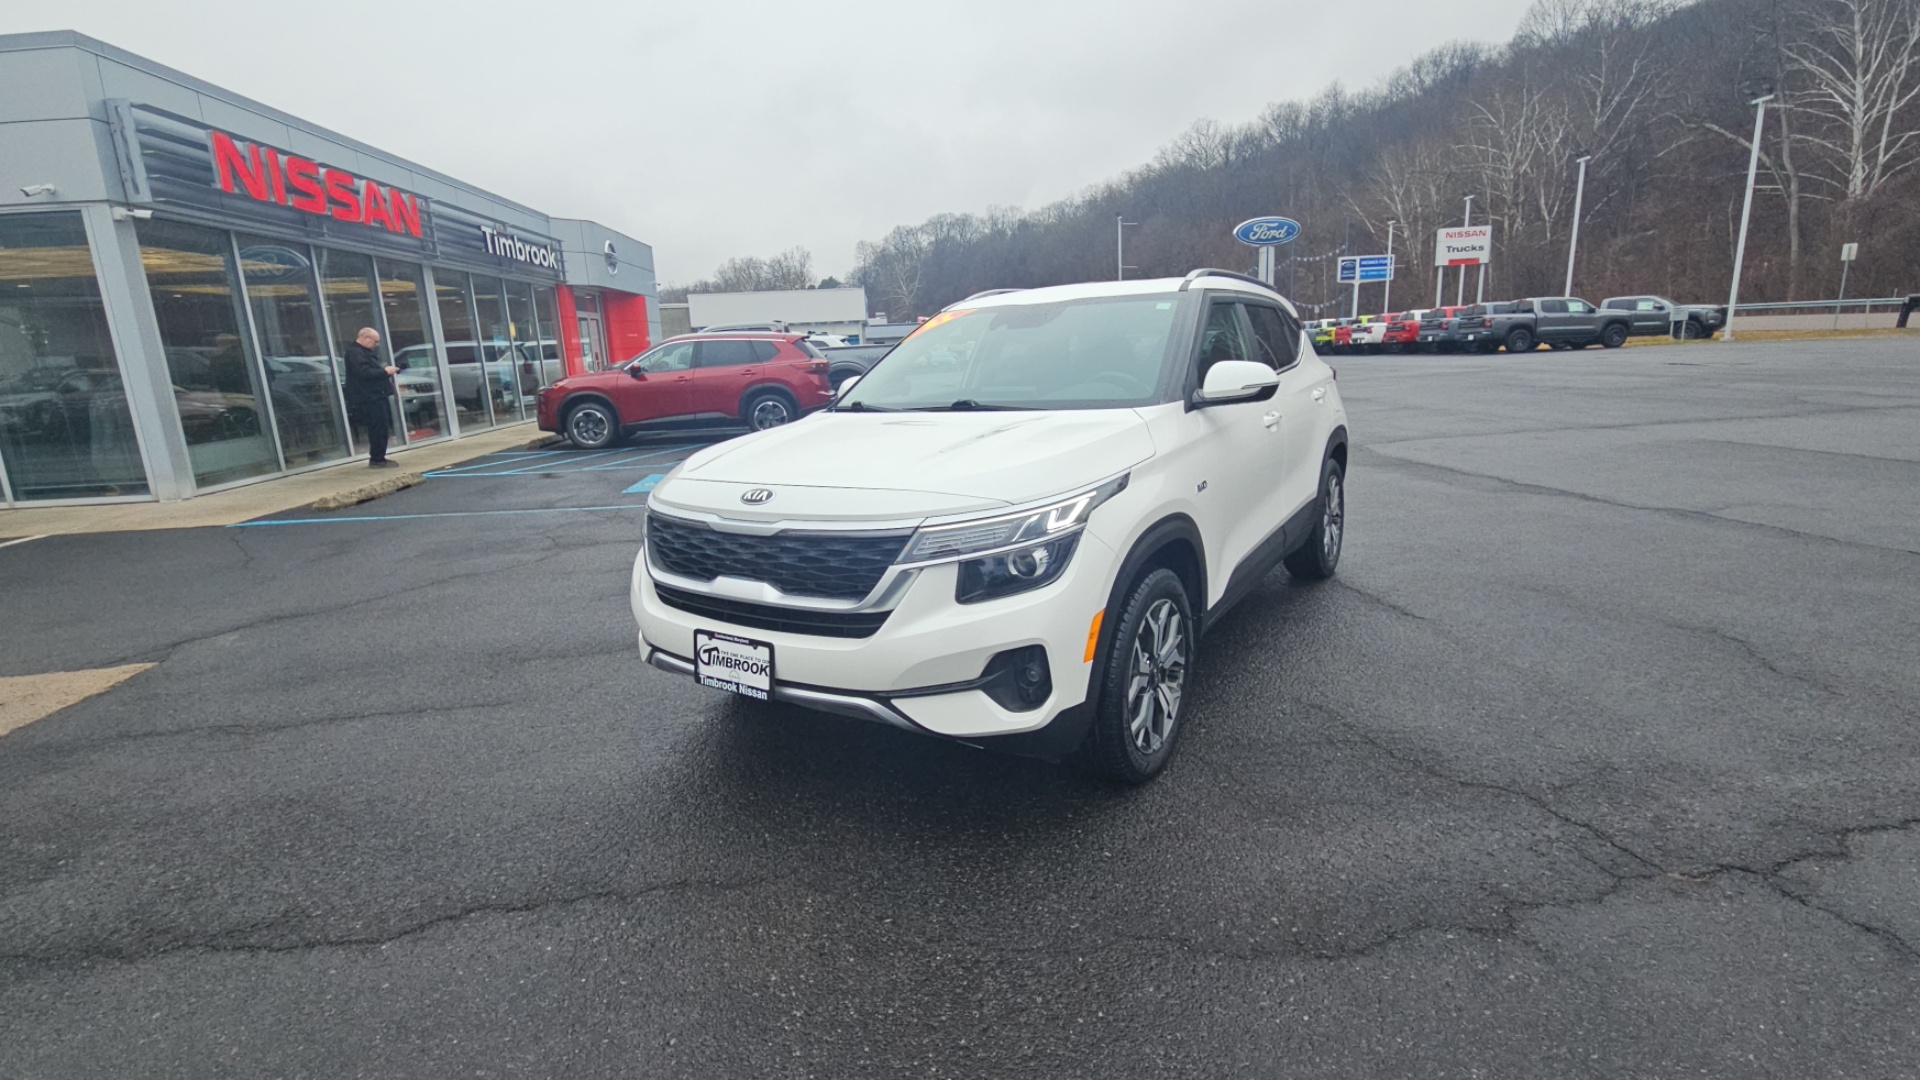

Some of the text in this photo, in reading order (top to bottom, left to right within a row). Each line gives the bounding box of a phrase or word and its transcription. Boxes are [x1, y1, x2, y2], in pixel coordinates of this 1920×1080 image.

[211, 130, 423, 239] NISSAN
[1249, 222, 1289, 241] Ford
[1446, 230, 1487, 239] NISSAN
[480, 225, 558, 269] Timbrook
[1446, 244, 1485, 253] Trucks
[743, 489, 770, 502] KIA
[698, 644, 769, 677] TIMBROOK
[699, 675, 767, 700] Timbrook Nissan
